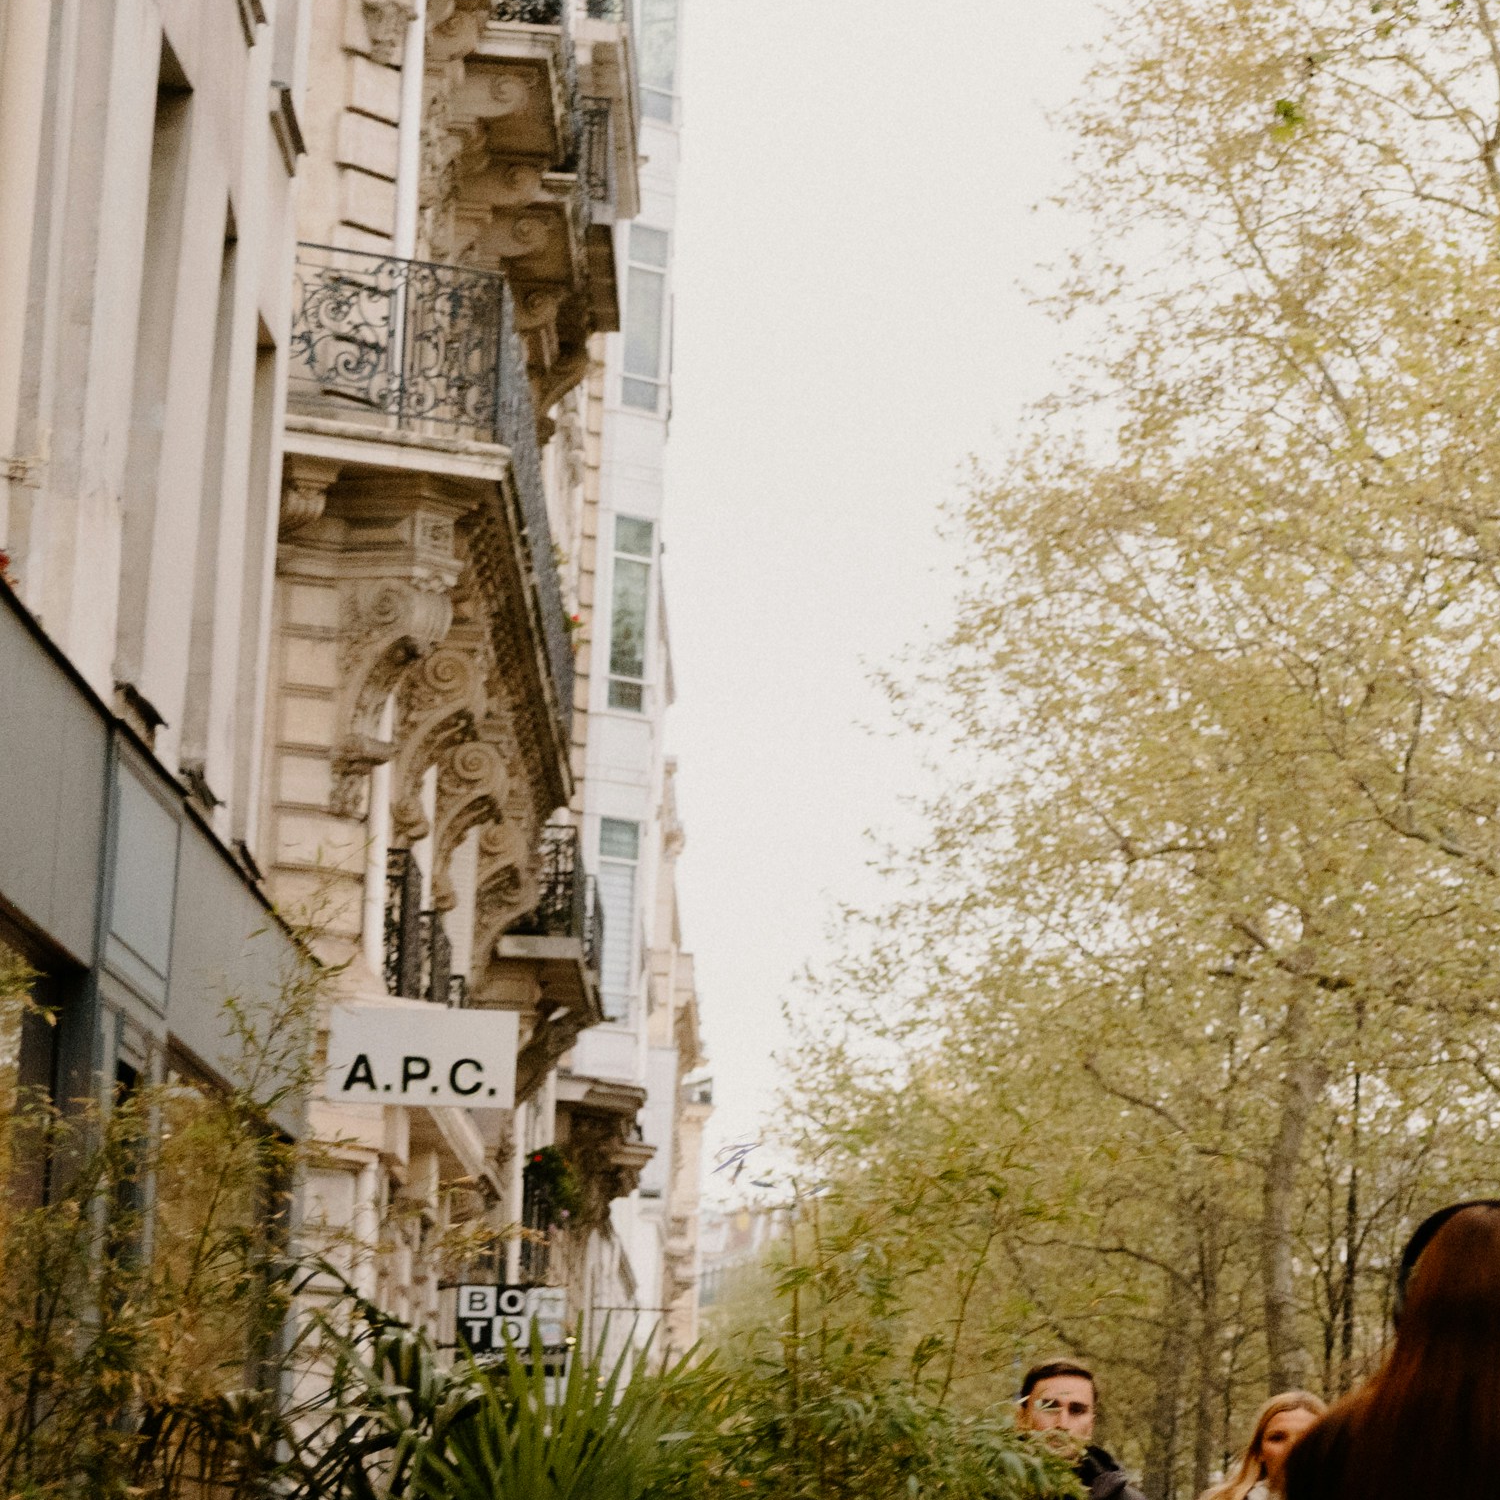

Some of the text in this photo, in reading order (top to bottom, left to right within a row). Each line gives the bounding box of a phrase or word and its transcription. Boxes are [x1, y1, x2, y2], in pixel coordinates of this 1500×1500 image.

[343, 1053, 497, 1097] A.P.C.
[469, 1290, 540, 1314] BO
[465, 1319, 537, 1344] TO
